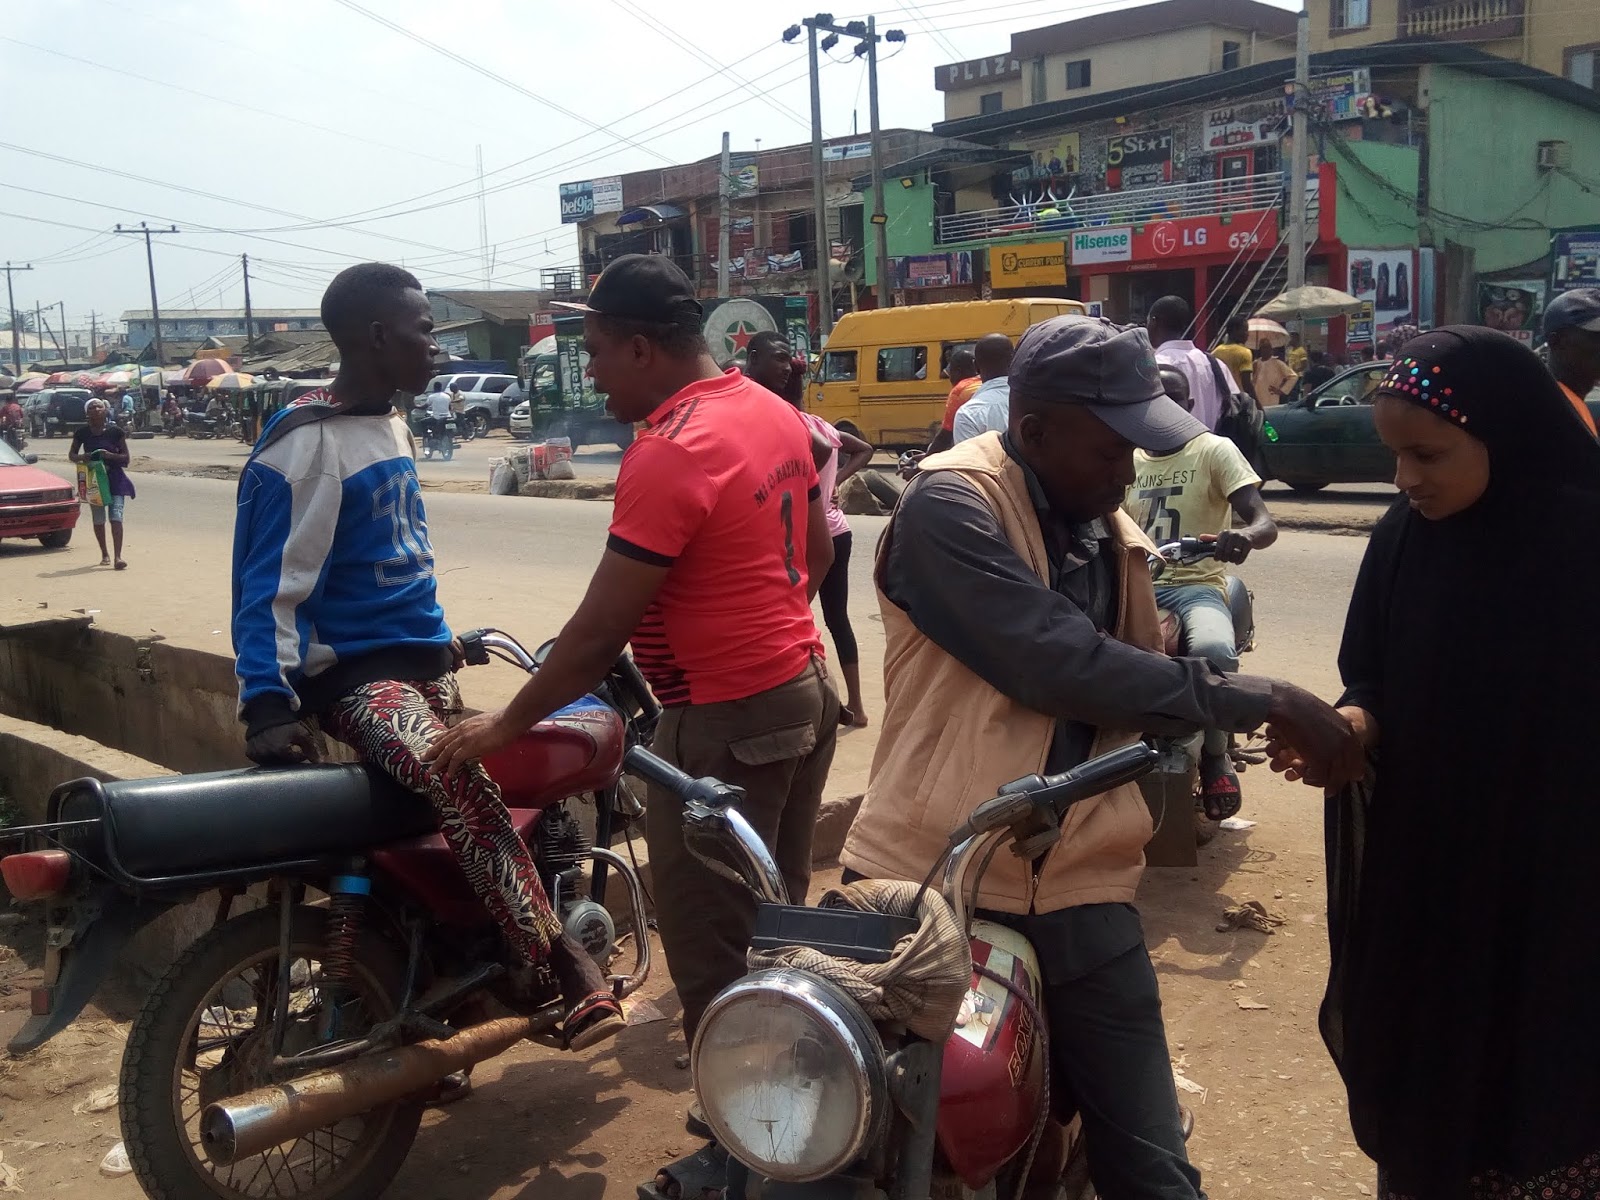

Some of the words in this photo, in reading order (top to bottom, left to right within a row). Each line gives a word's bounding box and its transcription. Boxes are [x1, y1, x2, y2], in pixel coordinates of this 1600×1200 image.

[949, 56, 1020, 84] PLAZA
[562, 195, 593, 215] bet9ja
[1074, 232, 1128, 251] Hisense
[1183, 228, 1207, 247] LG
[568, 339, 581, 407] Heineken
[1127, 469, 1197, 491] KJNS-EST
[1007, 984, 1035, 1087] BOXE
